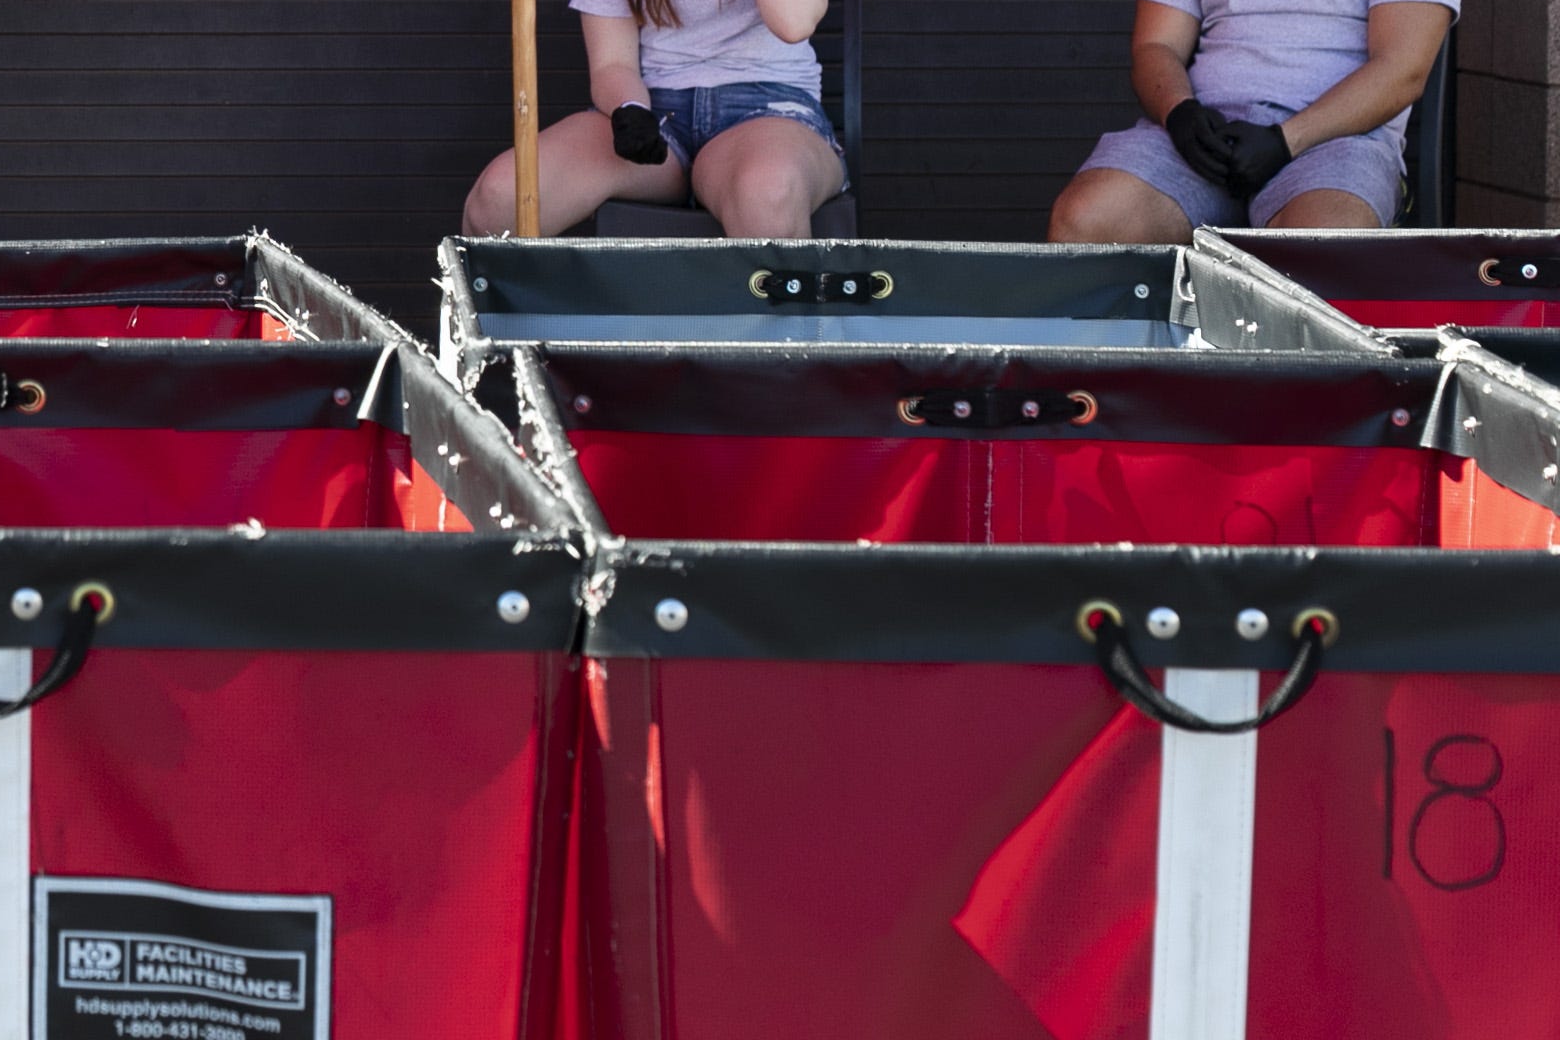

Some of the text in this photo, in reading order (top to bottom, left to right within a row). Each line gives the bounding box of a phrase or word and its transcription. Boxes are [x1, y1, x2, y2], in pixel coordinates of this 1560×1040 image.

[1382, 726, 1507, 892] 18
[69, 967, 122, 981] SUPPLY
[136, 942, 247, 976] FACILITIES
[75, 996, 281, 1034] hdsupplysolutions.com
